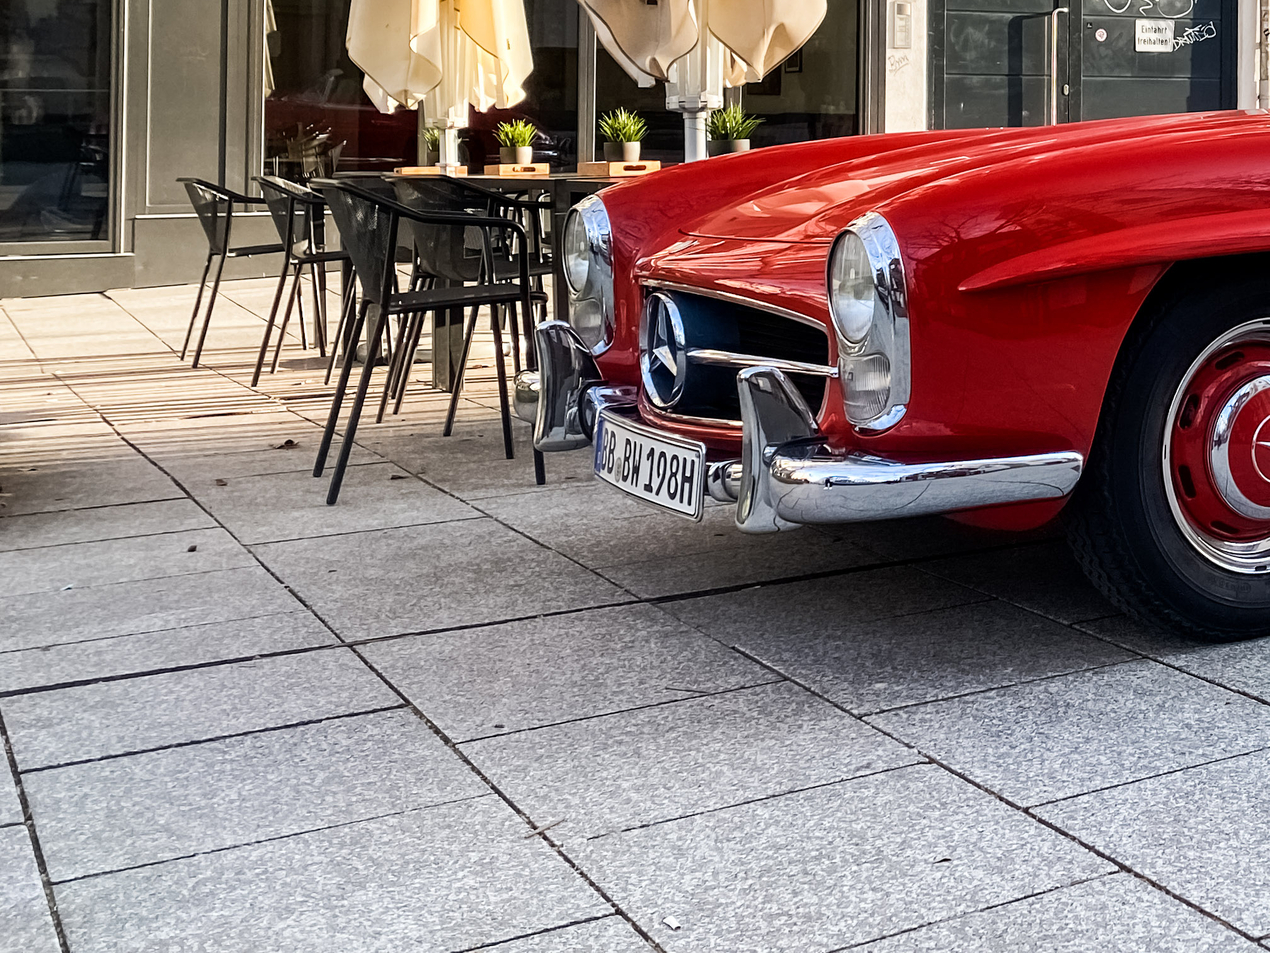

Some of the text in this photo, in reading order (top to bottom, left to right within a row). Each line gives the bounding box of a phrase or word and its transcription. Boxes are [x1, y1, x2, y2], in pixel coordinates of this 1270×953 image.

[1141, 25, 1168, 34] Einfahrt
[602, 428, 695, 506] BB BW 198H
